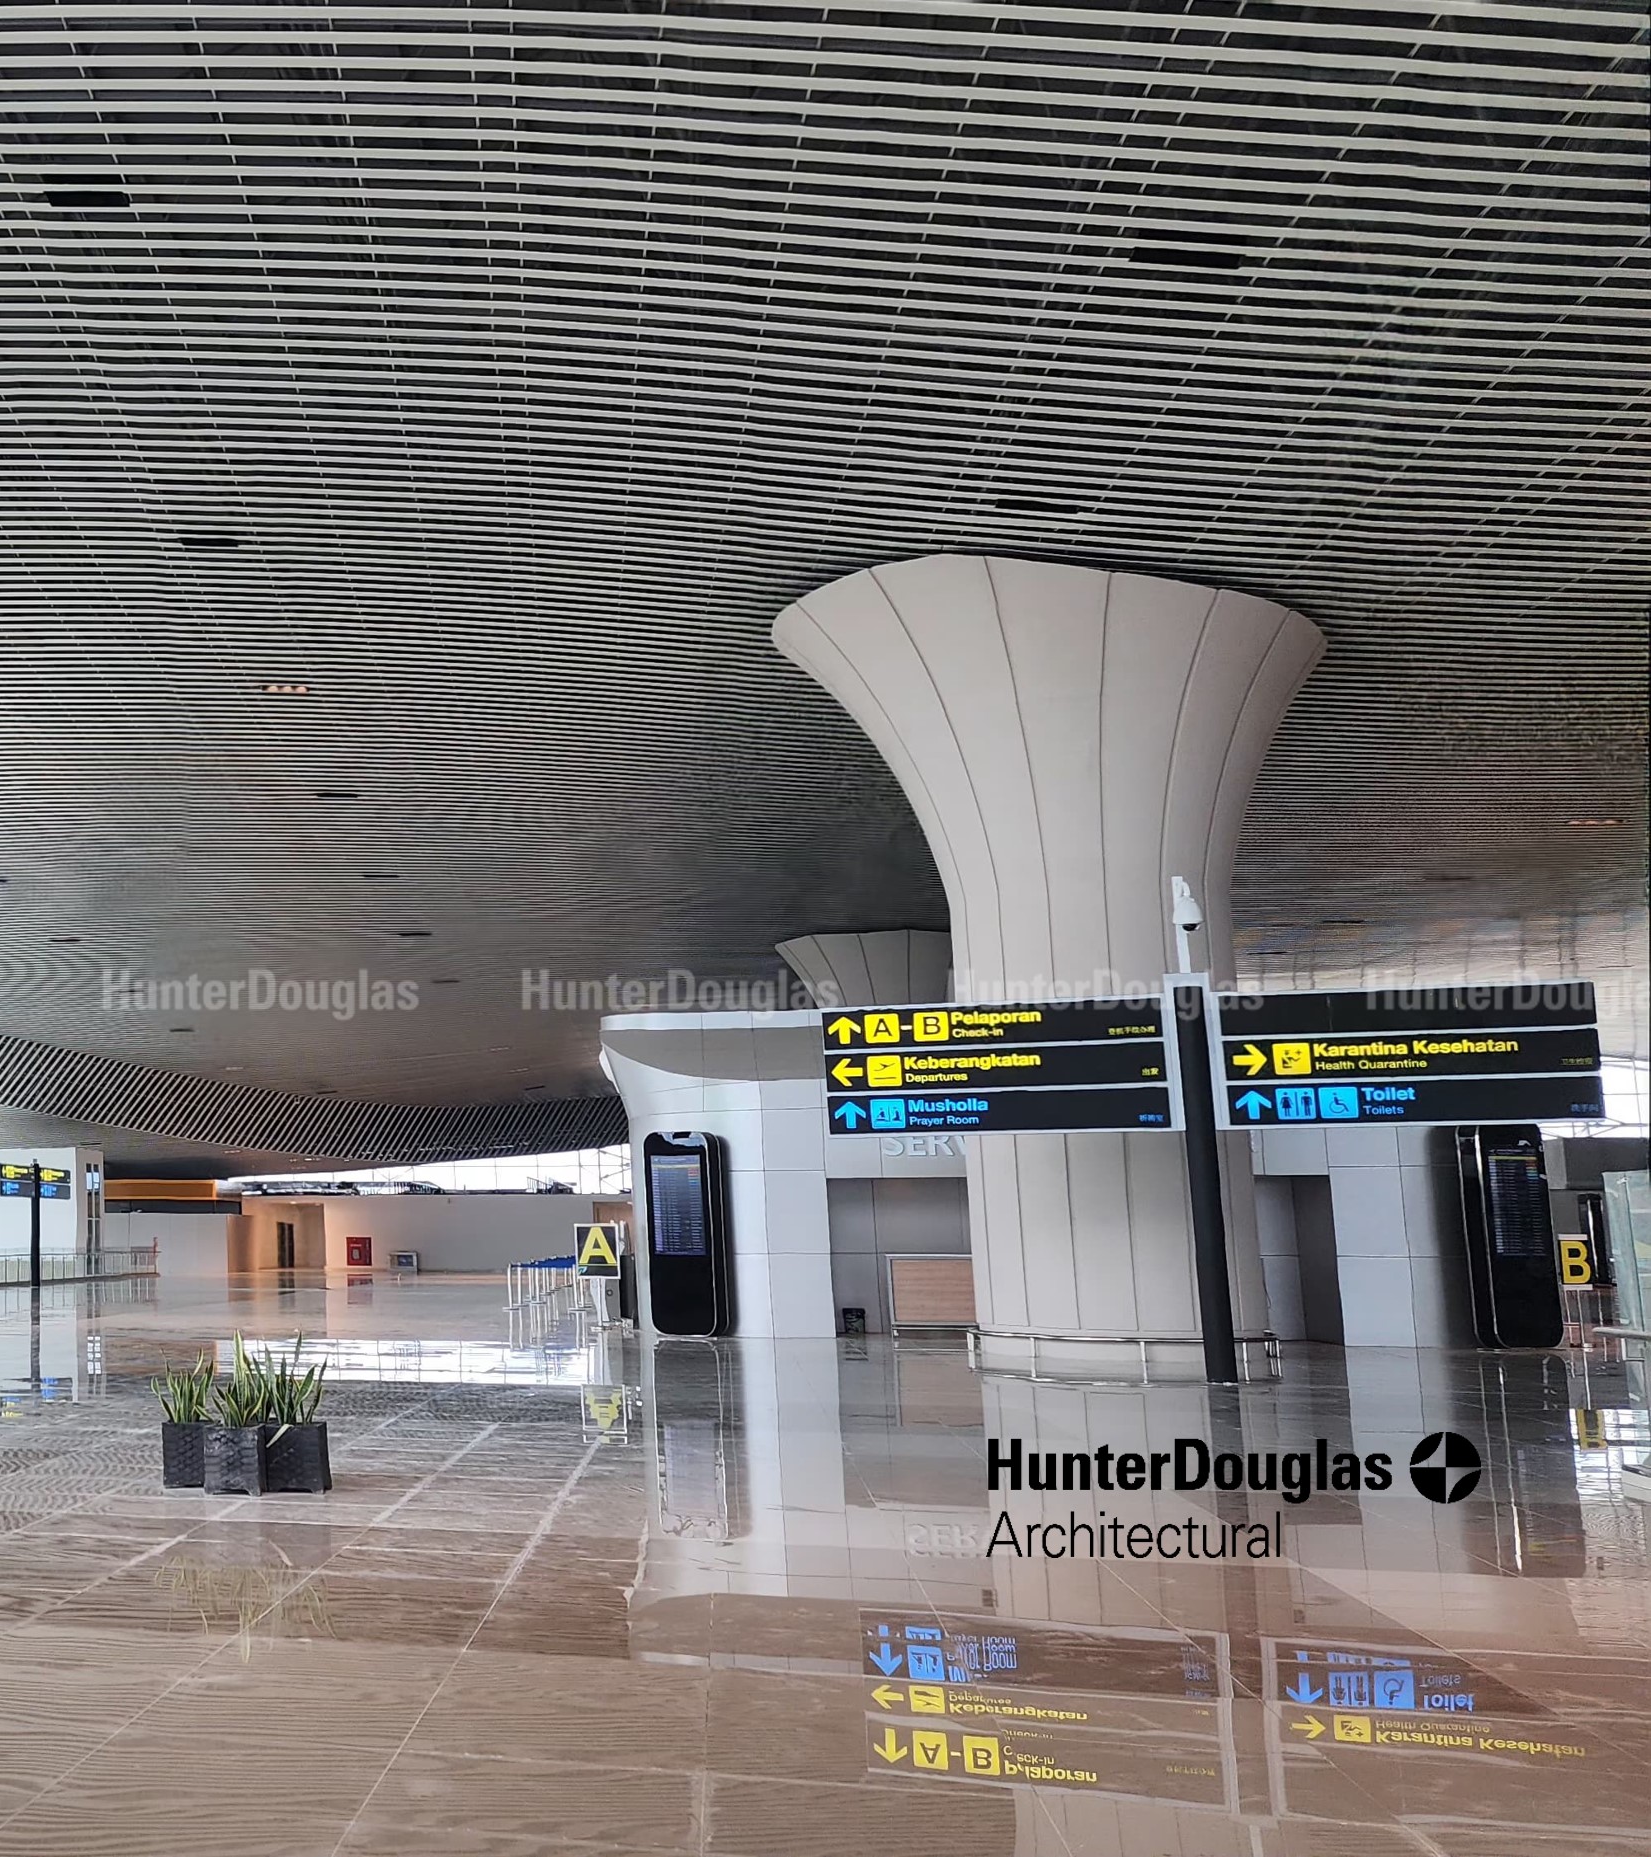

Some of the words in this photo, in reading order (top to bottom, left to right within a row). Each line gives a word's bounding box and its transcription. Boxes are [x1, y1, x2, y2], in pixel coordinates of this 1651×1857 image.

[951, 1011, 1042, 1026] Pelaporan
[952, 1028, 1003, 1038] Check-in
[1313, 1041, 1408, 1058] Karantina
[1412, 1039, 1519, 1055] Kesehatan
[904, 1054, 1041, 1070] Keberangkatan
[1315, 1059, 1355, 1071] Health
[1359, 1058, 1428, 1070] Quarantine
[905, 1073, 968, 1083] Departures
[1361, 1087, 1415, 1102] Toilet
[908, 1098, 989, 1113] Musholla
[1363, 1105, 1404, 1115] Toilets
[909, 1116, 944, 1127] Prayer
[947, 1115, 979, 1125] Room
[579, 1227, 617, 1264] A
[1560, 1240, 1591, 1284] B
